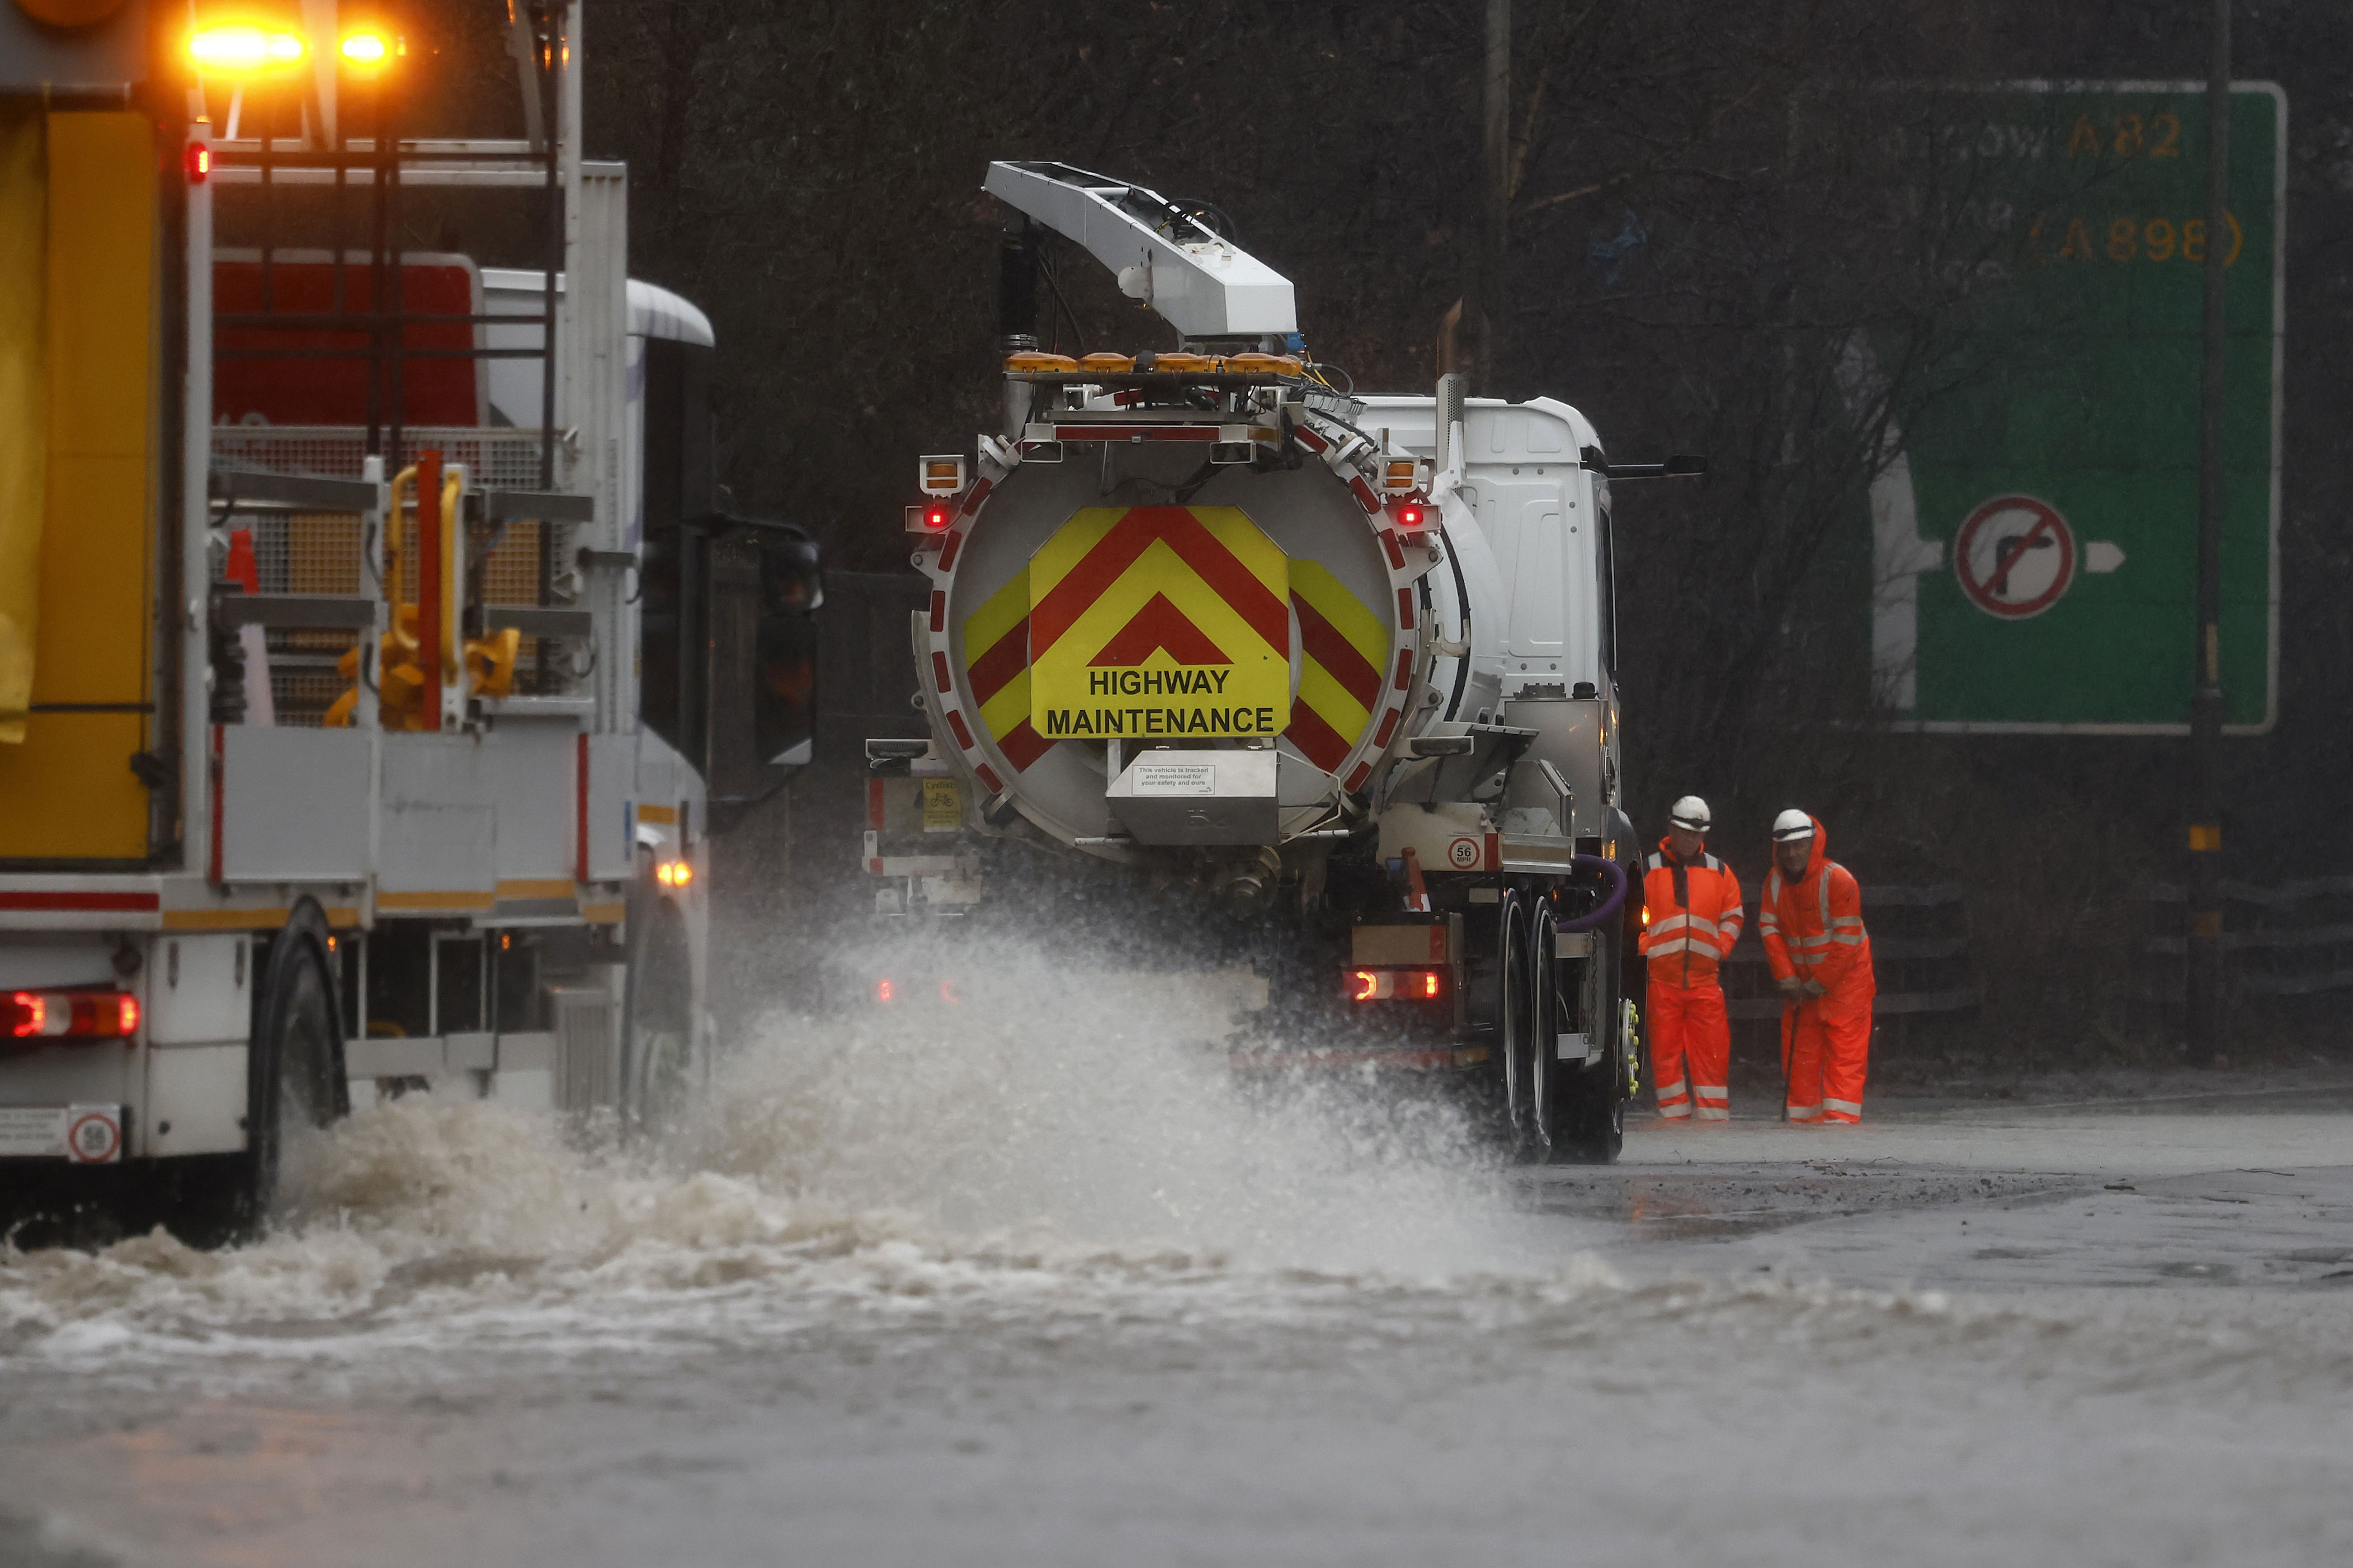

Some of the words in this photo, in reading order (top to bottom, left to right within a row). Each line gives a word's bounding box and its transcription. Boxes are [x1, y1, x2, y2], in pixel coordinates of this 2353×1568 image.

[2068, 113, 2181, 158] A82
[1090, 669, 1230, 696] HIGHWAY
[1047, 707, 1274, 735] MAINTENANCE
[1456, 847, 1472, 857] 56
